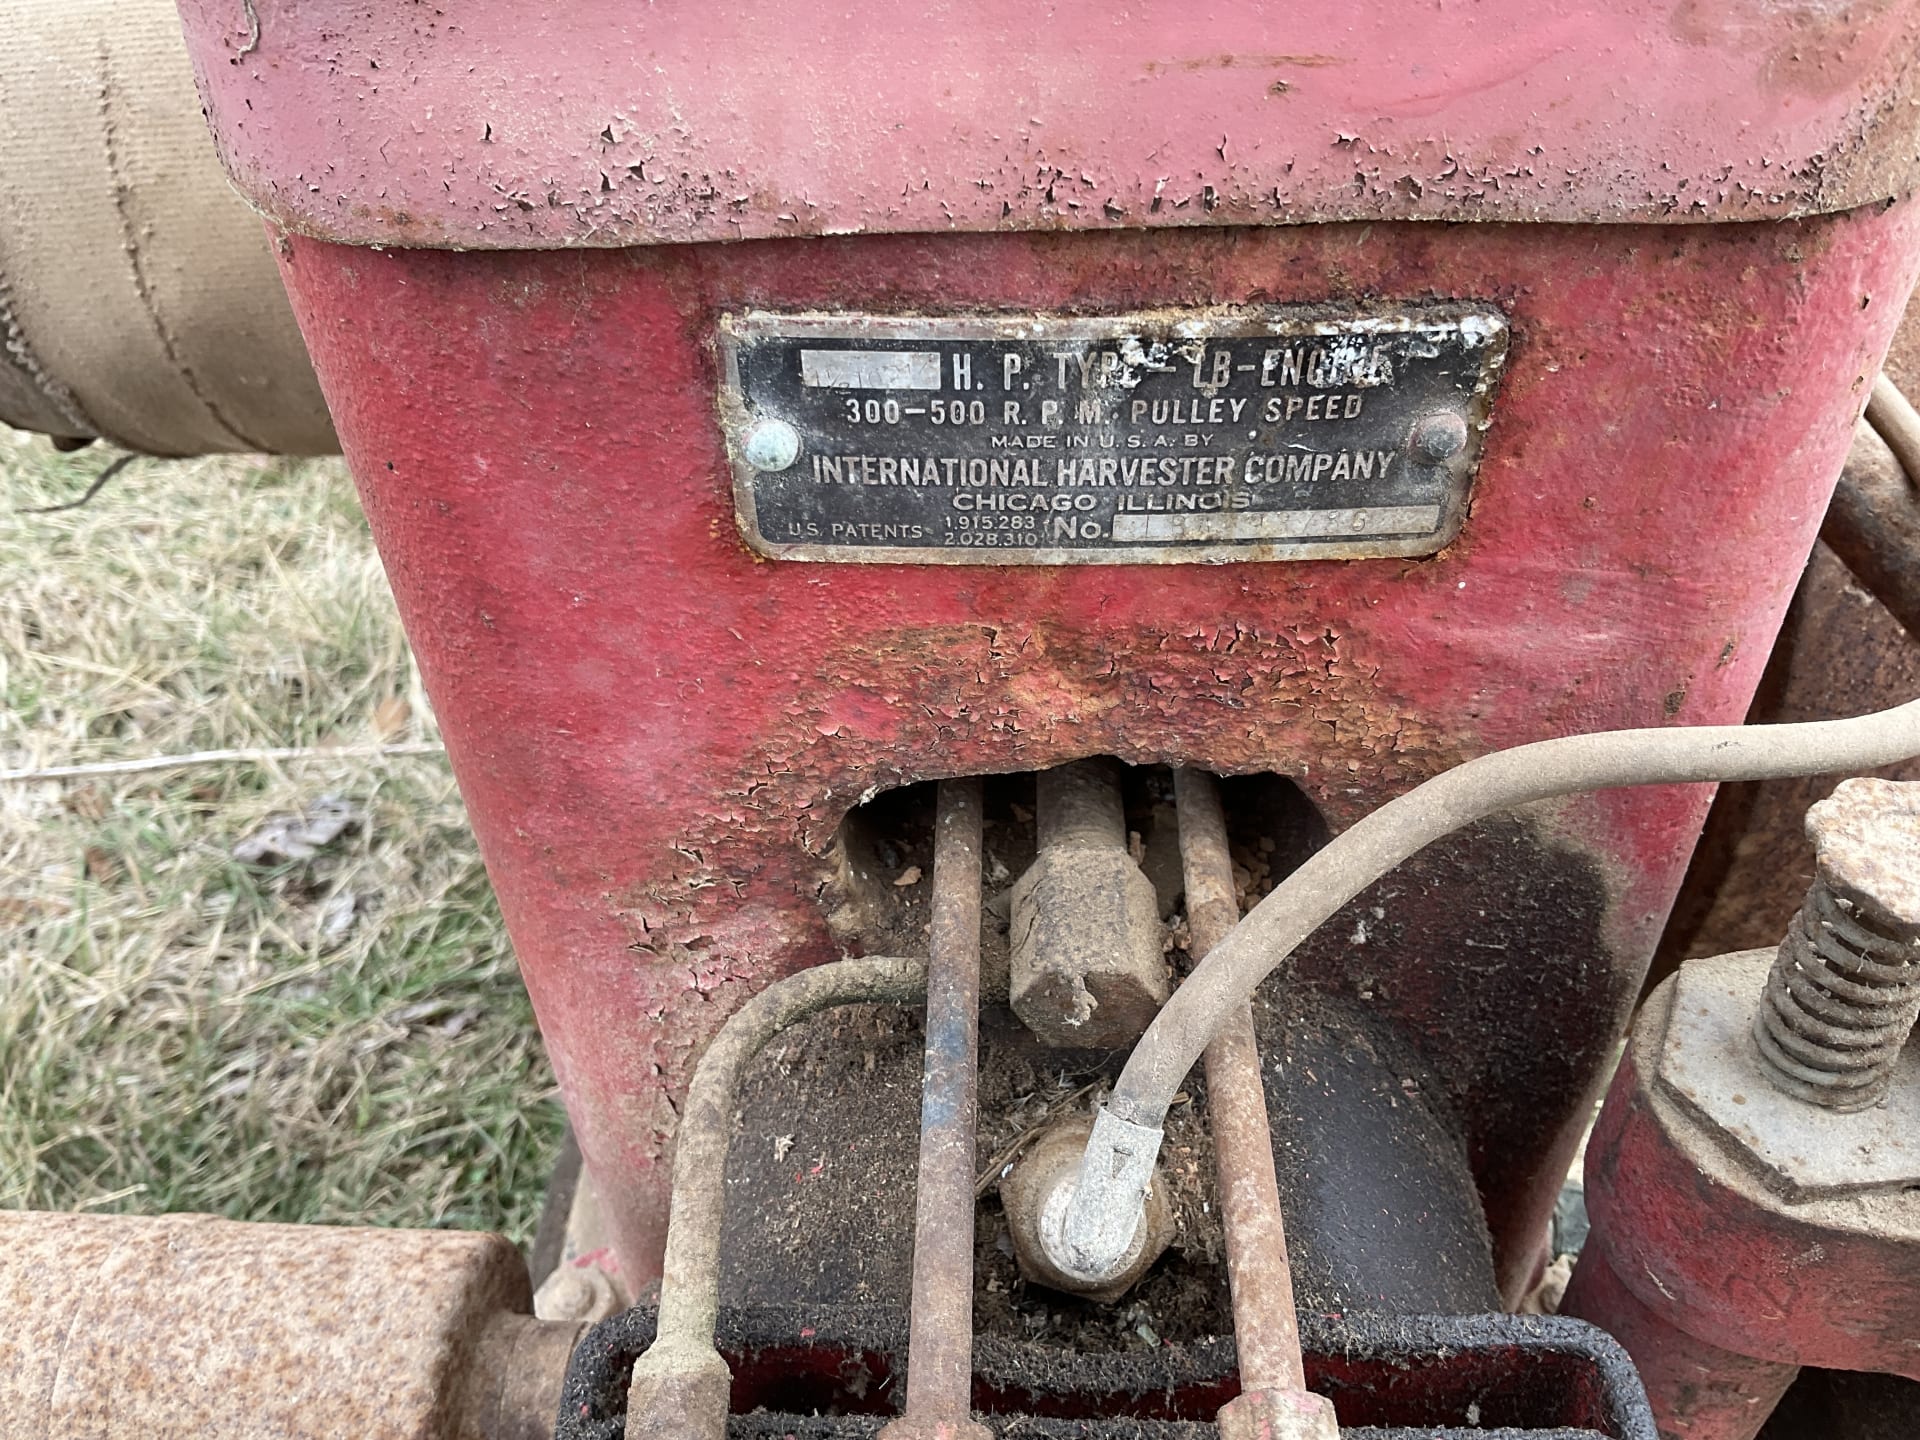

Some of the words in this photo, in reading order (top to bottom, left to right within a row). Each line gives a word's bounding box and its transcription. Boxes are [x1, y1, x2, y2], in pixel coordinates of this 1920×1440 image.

[846, 400, 985, 425] 300-500
[1004, 400, 1027, 425] R.
[1131, 398, 1247, 426] PULLEY
[1264, 394, 1363, 423] SPEED
[991, 436, 1056, 449] MADE
[1067, 436, 1089, 448] IN
[1184, 434, 1214, 447] BY
[812, 455, 1048, 488] INTERNATIONAL
[1057, 456, 1235, 487] HARVESTER
[1244, 450, 1395, 484] COMPANY
[952, 493, 1097, 511] CHICAGO
[1117, 492, 1251, 511] ILLINOIS
[832, 524, 923, 539] PATENTS
